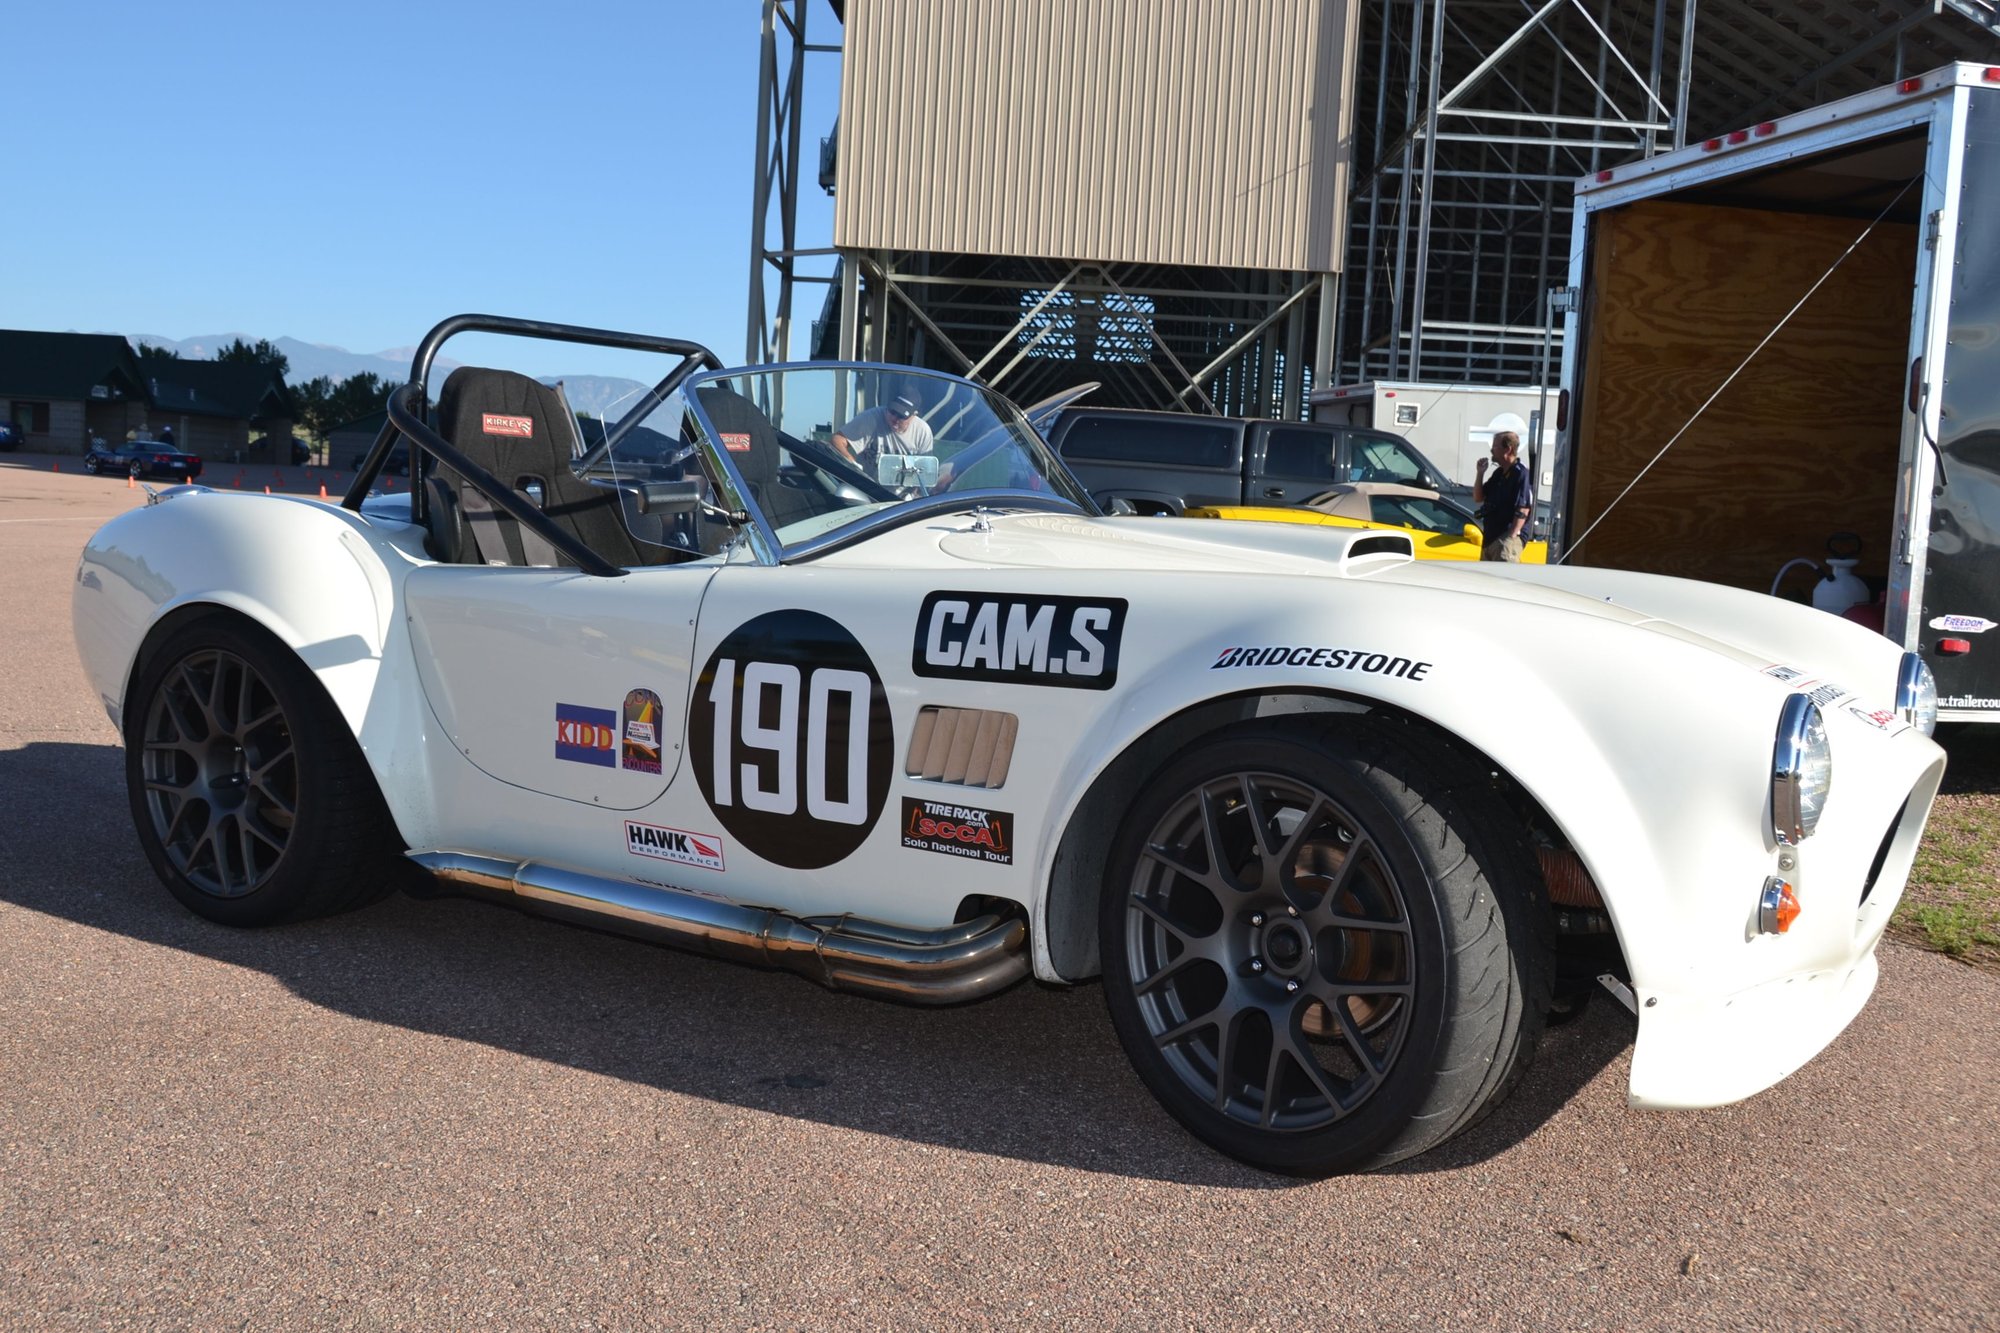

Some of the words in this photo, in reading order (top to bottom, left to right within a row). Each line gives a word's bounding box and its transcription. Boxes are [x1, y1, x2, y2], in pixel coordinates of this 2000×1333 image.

[486, 417, 522, 428] KIRKEY
[1944, 616, 1984, 627] FREEDOM
[925, 600, 1112, 677] CAM.S
[1210, 647, 1433, 682] BRIDGESTONE
[557, 719, 614, 751] KIDD
[708, 658, 872, 826] 190
[622, 757, 662, 776] ENCOUNTERS
[924, 802, 952, 817] TIRE
[953, 806, 990, 829] RACK
[965, 820, 984, 828] .com
[629, 825, 690, 854] HAWK
[919, 818, 995, 847] SCCA
[631, 845, 720, 867] PERFORMANCE
[904, 837, 928, 849] Solo
[931, 842, 980, 858] National
[984, 850, 1010, 863] Tour
